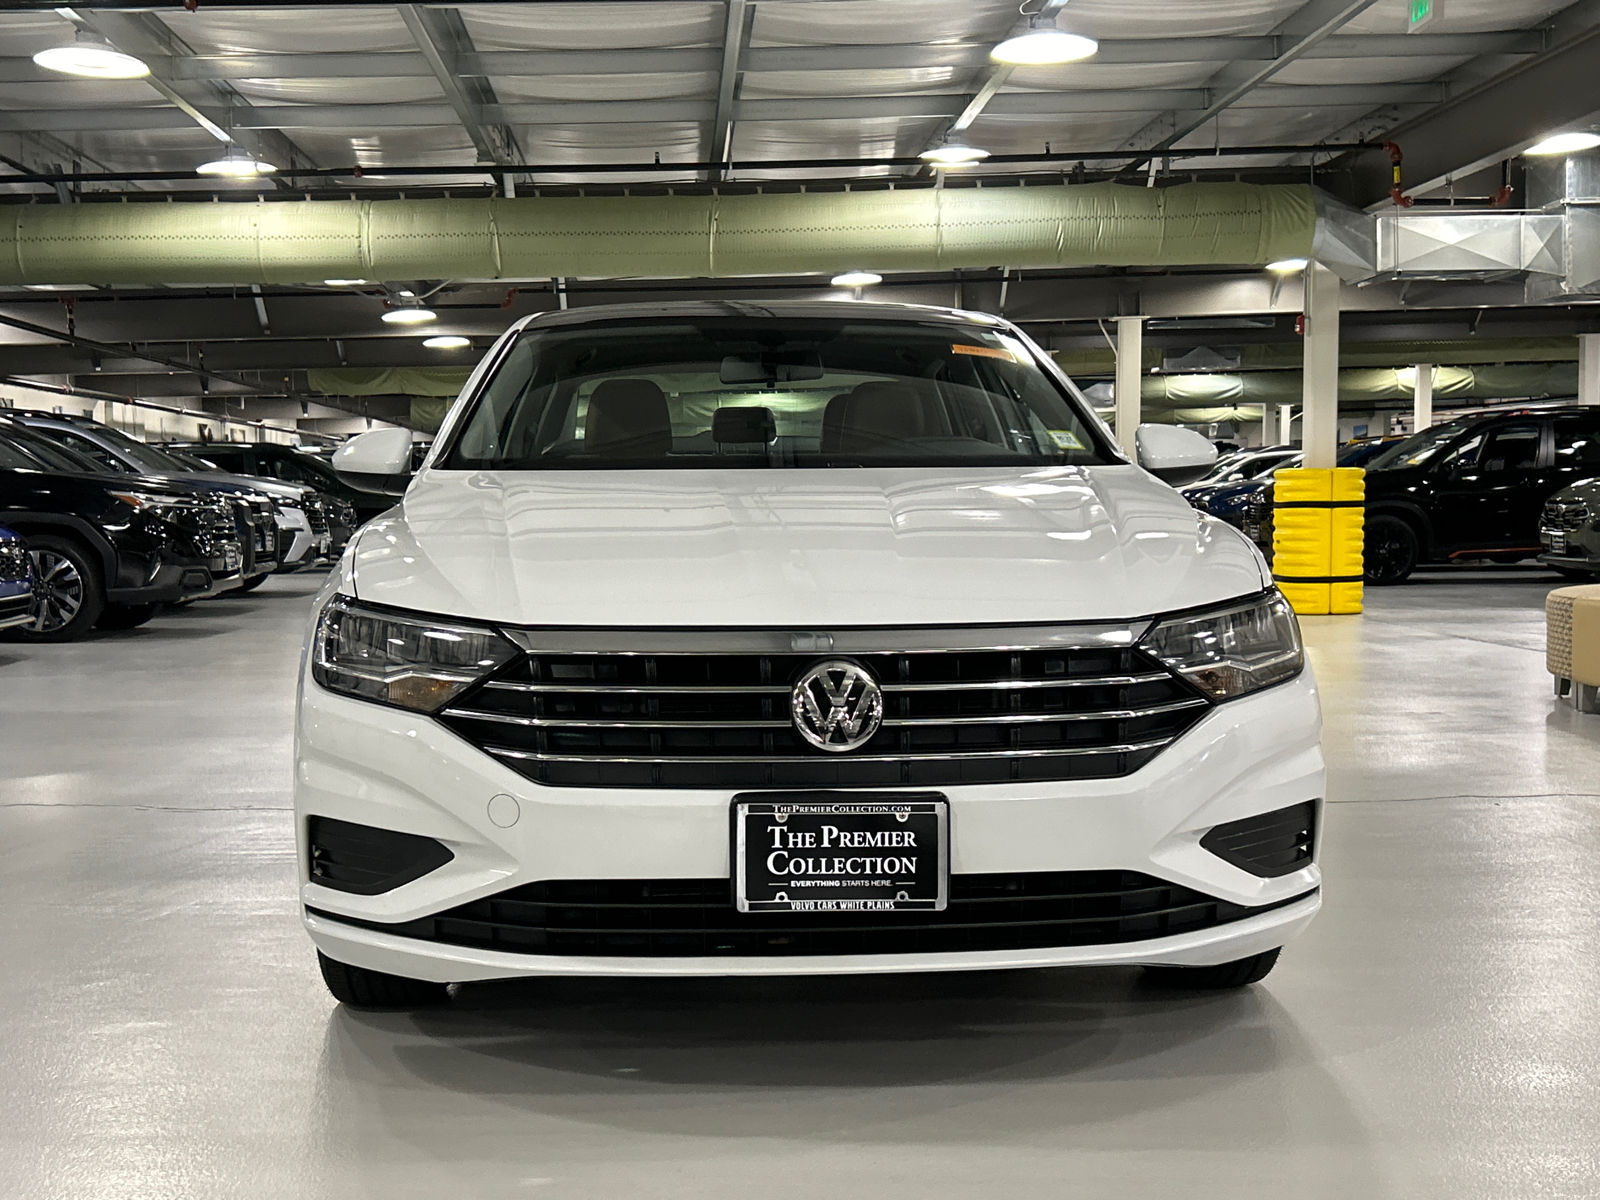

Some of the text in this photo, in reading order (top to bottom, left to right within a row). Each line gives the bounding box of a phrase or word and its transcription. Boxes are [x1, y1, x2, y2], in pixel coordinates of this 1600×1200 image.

[767, 825, 917, 848] THE PREMIER
[766, 850, 917, 875] COLLECTION
[790, 901, 895, 910] VOLVO CARS WHITE PLAINS
